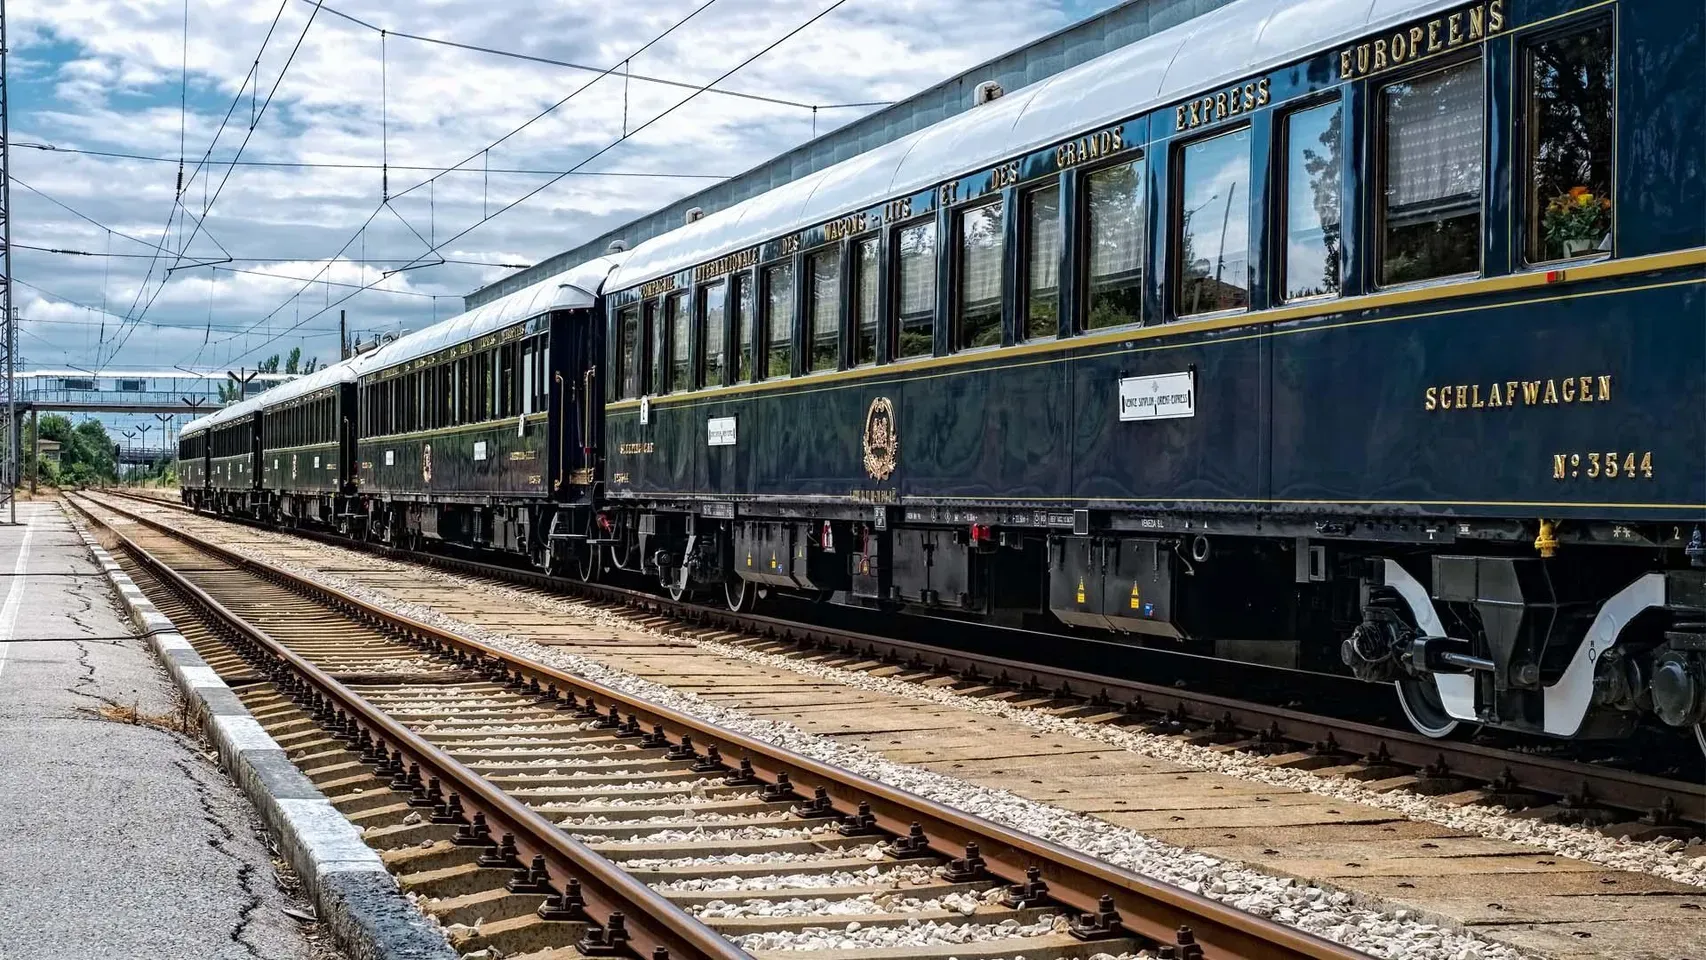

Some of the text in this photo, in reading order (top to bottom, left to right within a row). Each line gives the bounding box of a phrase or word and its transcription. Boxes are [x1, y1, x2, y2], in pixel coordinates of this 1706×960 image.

[782, 235, 799, 254] DES
[824, 213, 866, 242] WAGONS
[884, 198, 911, 223] LITS
[941, 181, 959, 205] ET
[991, 161, 1020, 190] DES
[1056, 126, 1124, 168] GRANDS
[1175, 78, 1272, 131] EXPRESS
[1340, 0, 1505, 80] EUROPEENS
[1425, 375, 1612, 411] SCHLAFWAGEN
[1673, 526, 1680, 540] 2
